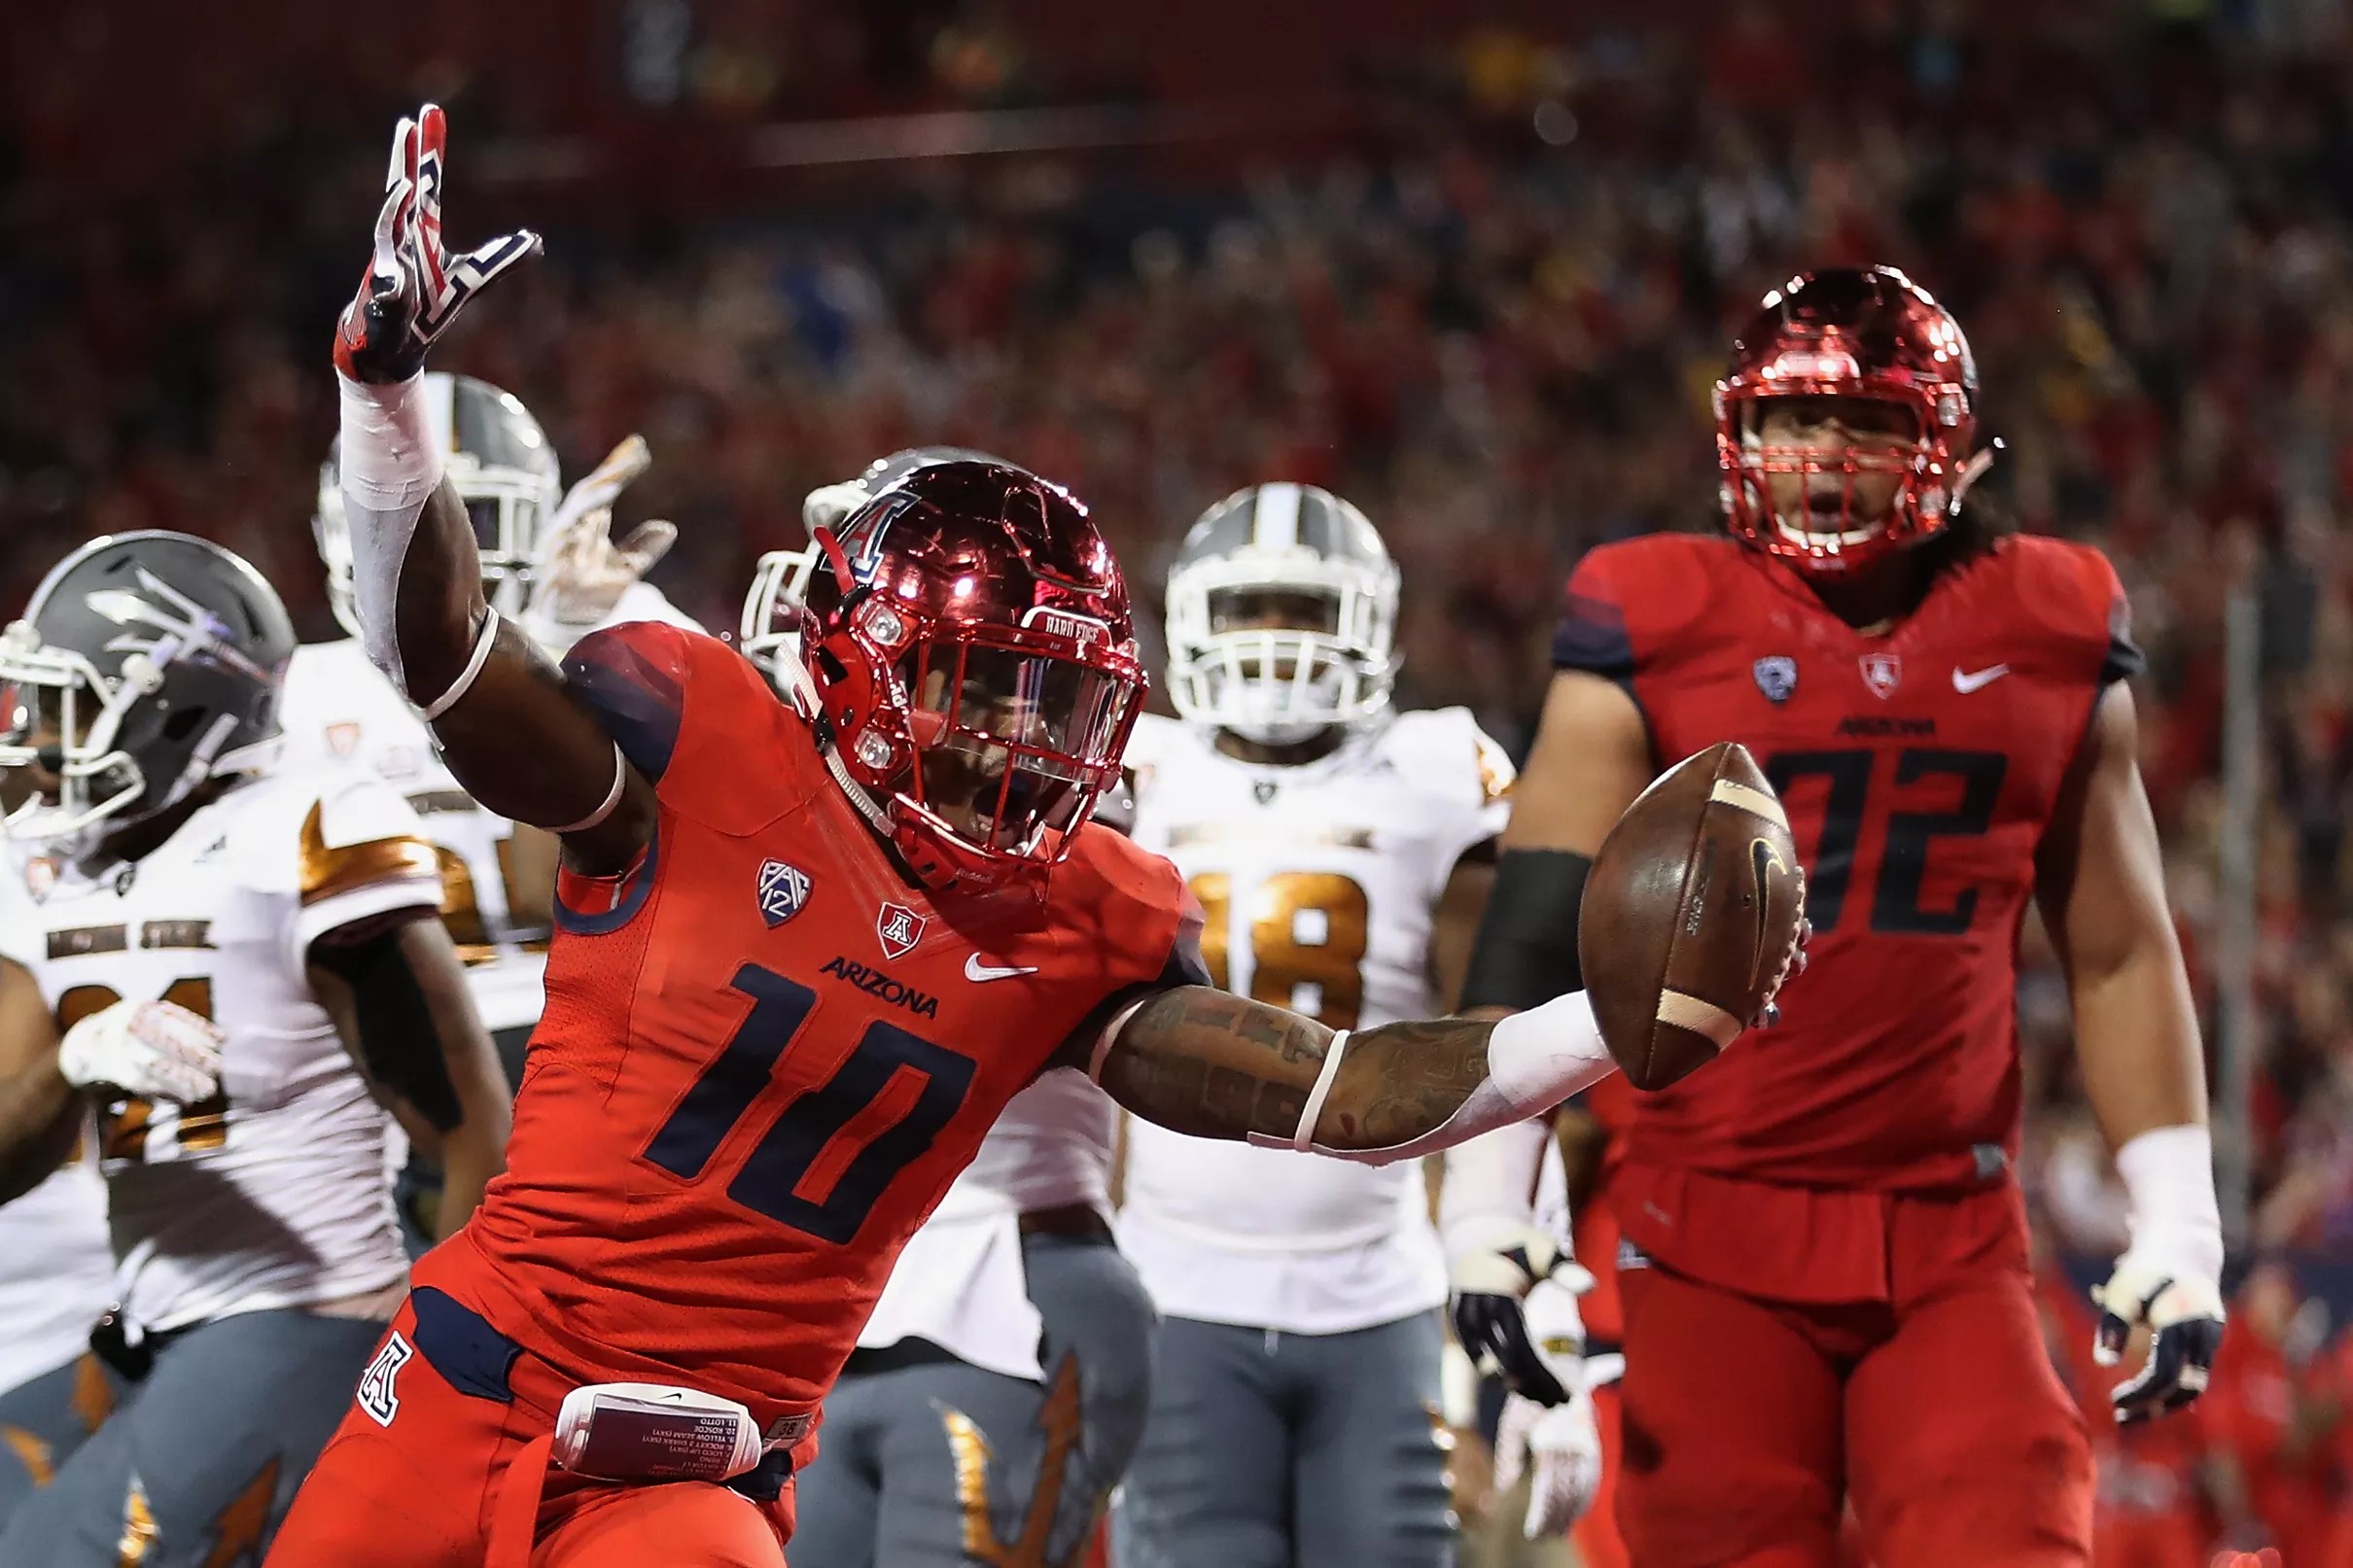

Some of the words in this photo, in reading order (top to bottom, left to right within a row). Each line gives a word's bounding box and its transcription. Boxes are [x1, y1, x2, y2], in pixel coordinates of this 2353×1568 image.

[1045, 615, 1073, 639] HARD
[1075, 622, 1099, 645] EDGE
[1767, 749, 2008, 935] 72
[759, 861, 810, 910] PAC
[761, 888, 792, 918] 12
[882, 911, 912, 947] A
[1185, 871, 1368, 1032] 18
[820, 957, 938, 1019] ARIZONA
[643, 962, 977, 1245] 10
[356, 1331, 414, 1428] A
[696, 1434, 726, 1443] YELLOW
